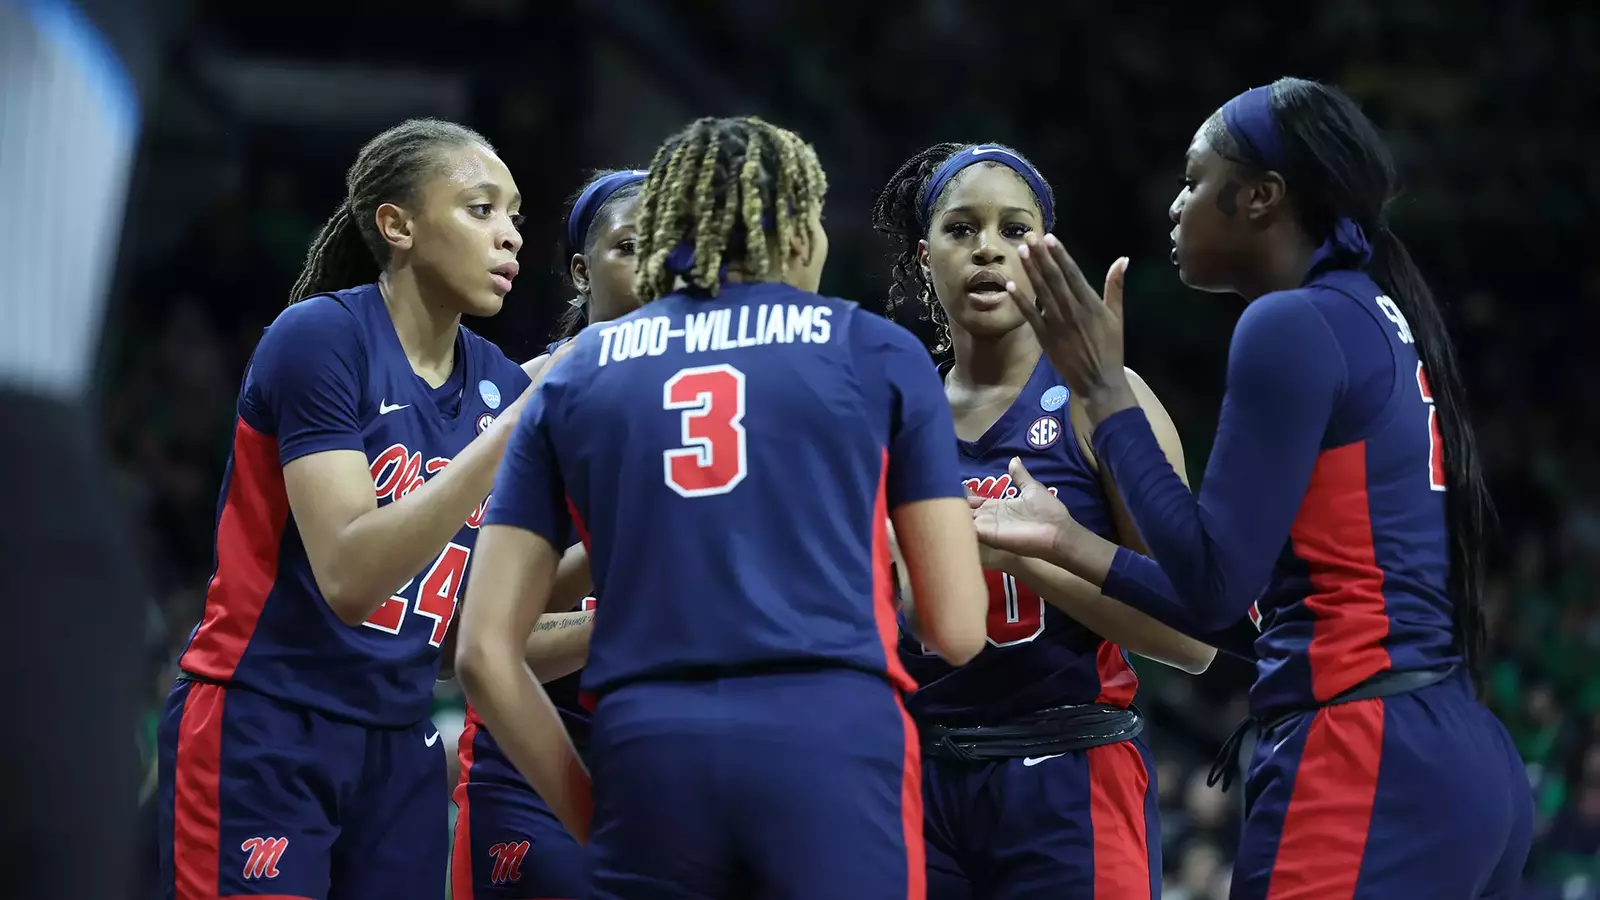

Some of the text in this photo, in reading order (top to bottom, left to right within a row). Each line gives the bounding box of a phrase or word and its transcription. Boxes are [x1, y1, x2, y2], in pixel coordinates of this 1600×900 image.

[598, 303, 832, 367] TODD-WILLIAMS
[663, 363, 747, 498] 3
[1030, 418, 1058, 446] SEC
[241, 836, 289, 880] M
[488, 840, 531, 884] M
